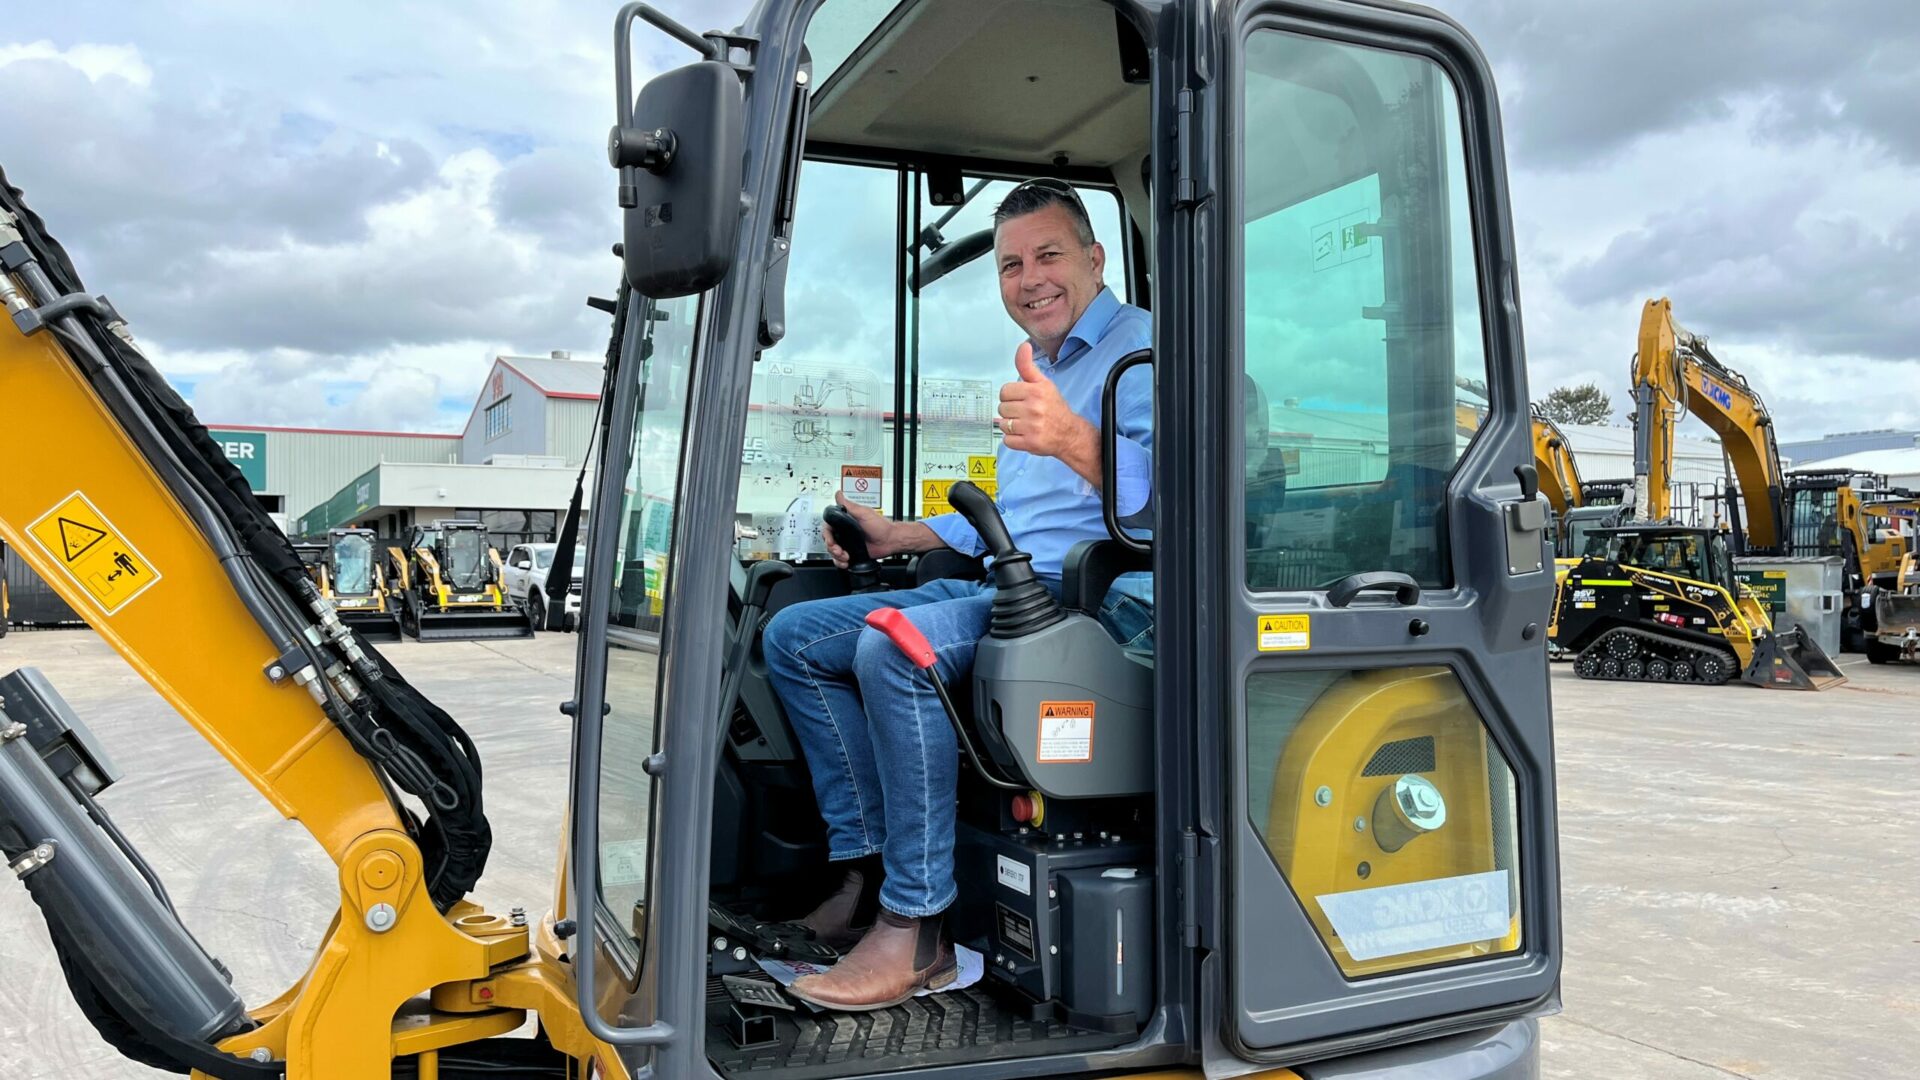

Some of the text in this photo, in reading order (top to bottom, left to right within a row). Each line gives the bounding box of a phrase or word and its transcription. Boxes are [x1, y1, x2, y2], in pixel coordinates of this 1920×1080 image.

[216, 441, 255, 459] ER
[853, 469, 879, 477] WARNING
[1274, 620, 1304, 631] CAUTION
[1055, 706, 1090, 716] WARNING
